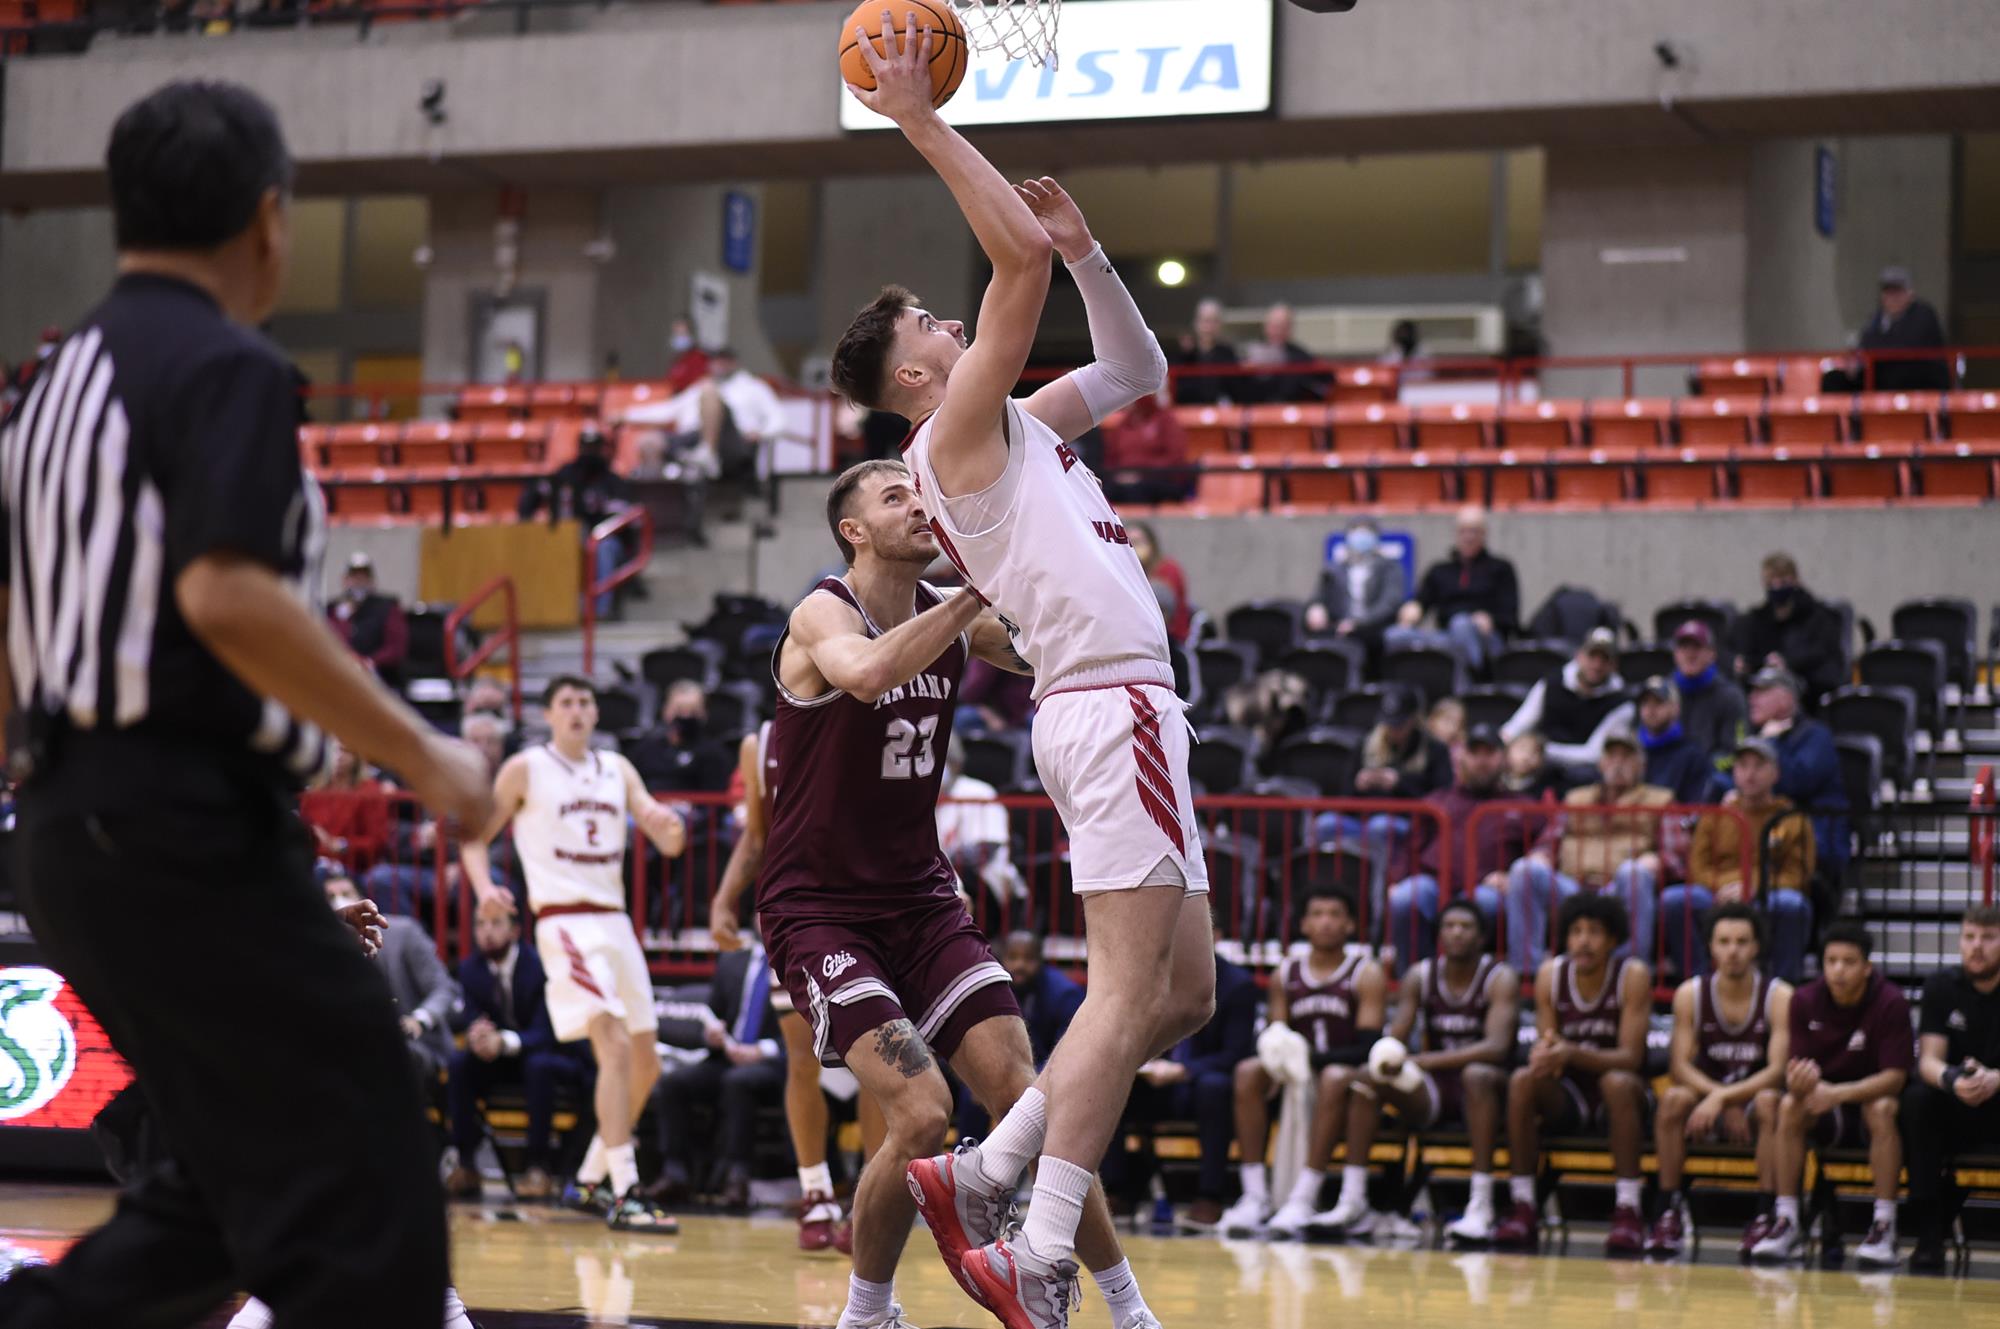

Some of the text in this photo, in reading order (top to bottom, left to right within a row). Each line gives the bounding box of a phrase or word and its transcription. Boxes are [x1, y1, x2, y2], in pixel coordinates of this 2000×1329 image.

[881, 714, 939, 779] 23
[585, 819, 600, 846] 2
[823, 950, 857, 979] Griz
